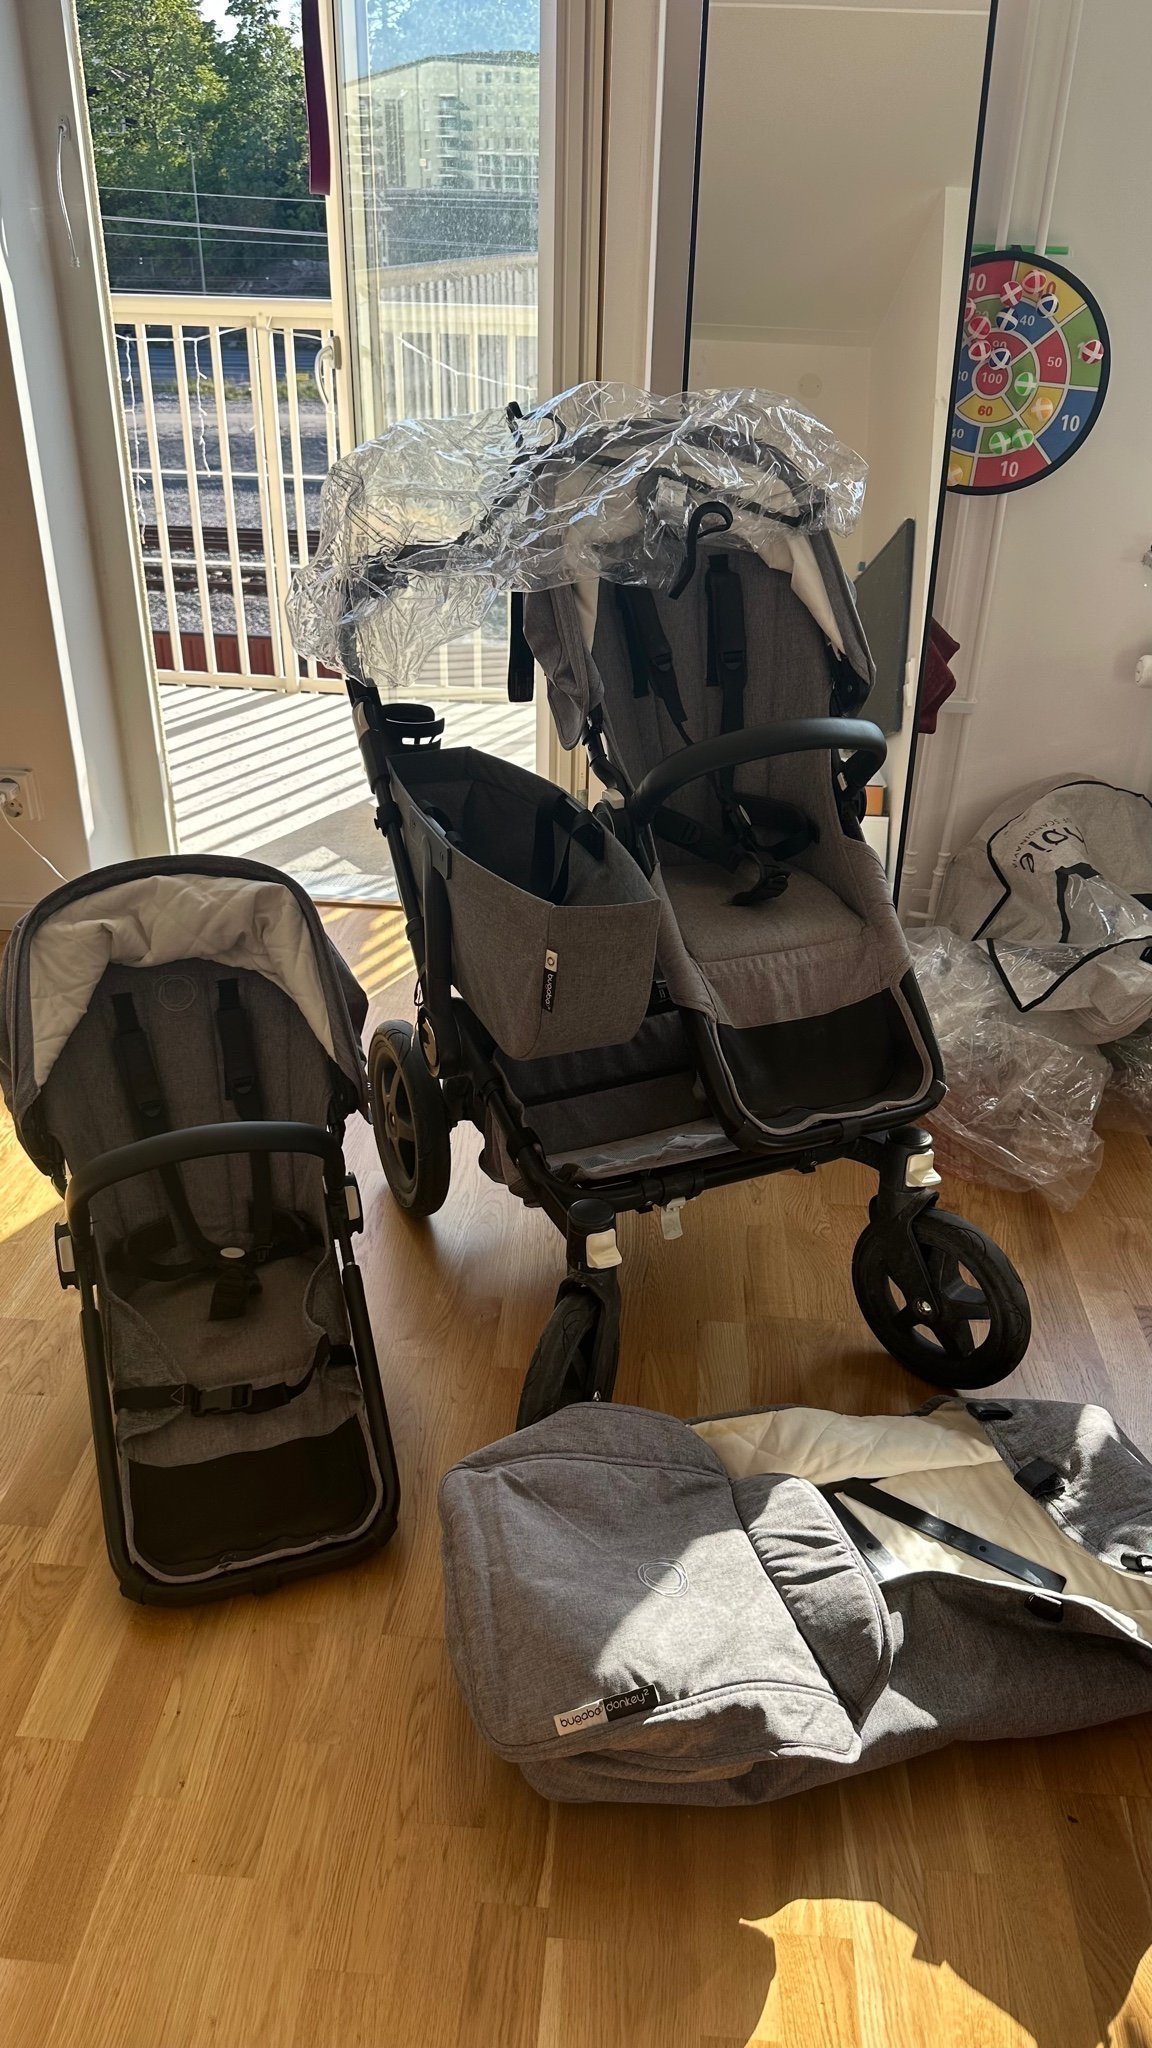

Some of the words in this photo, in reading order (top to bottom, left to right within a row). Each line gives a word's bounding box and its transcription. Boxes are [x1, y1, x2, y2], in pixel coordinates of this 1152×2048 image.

[1019, 314, 1035, 327] 40
[1046, 356, 1063, 368] 50
[981, 372, 1003, 385] 100
[977, 405, 993, 417] 60
[1061, 414, 1080, 432] 10
[1000, 460, 1019, 478] 10
[559, 1706, 603, 1727] bugaboo
